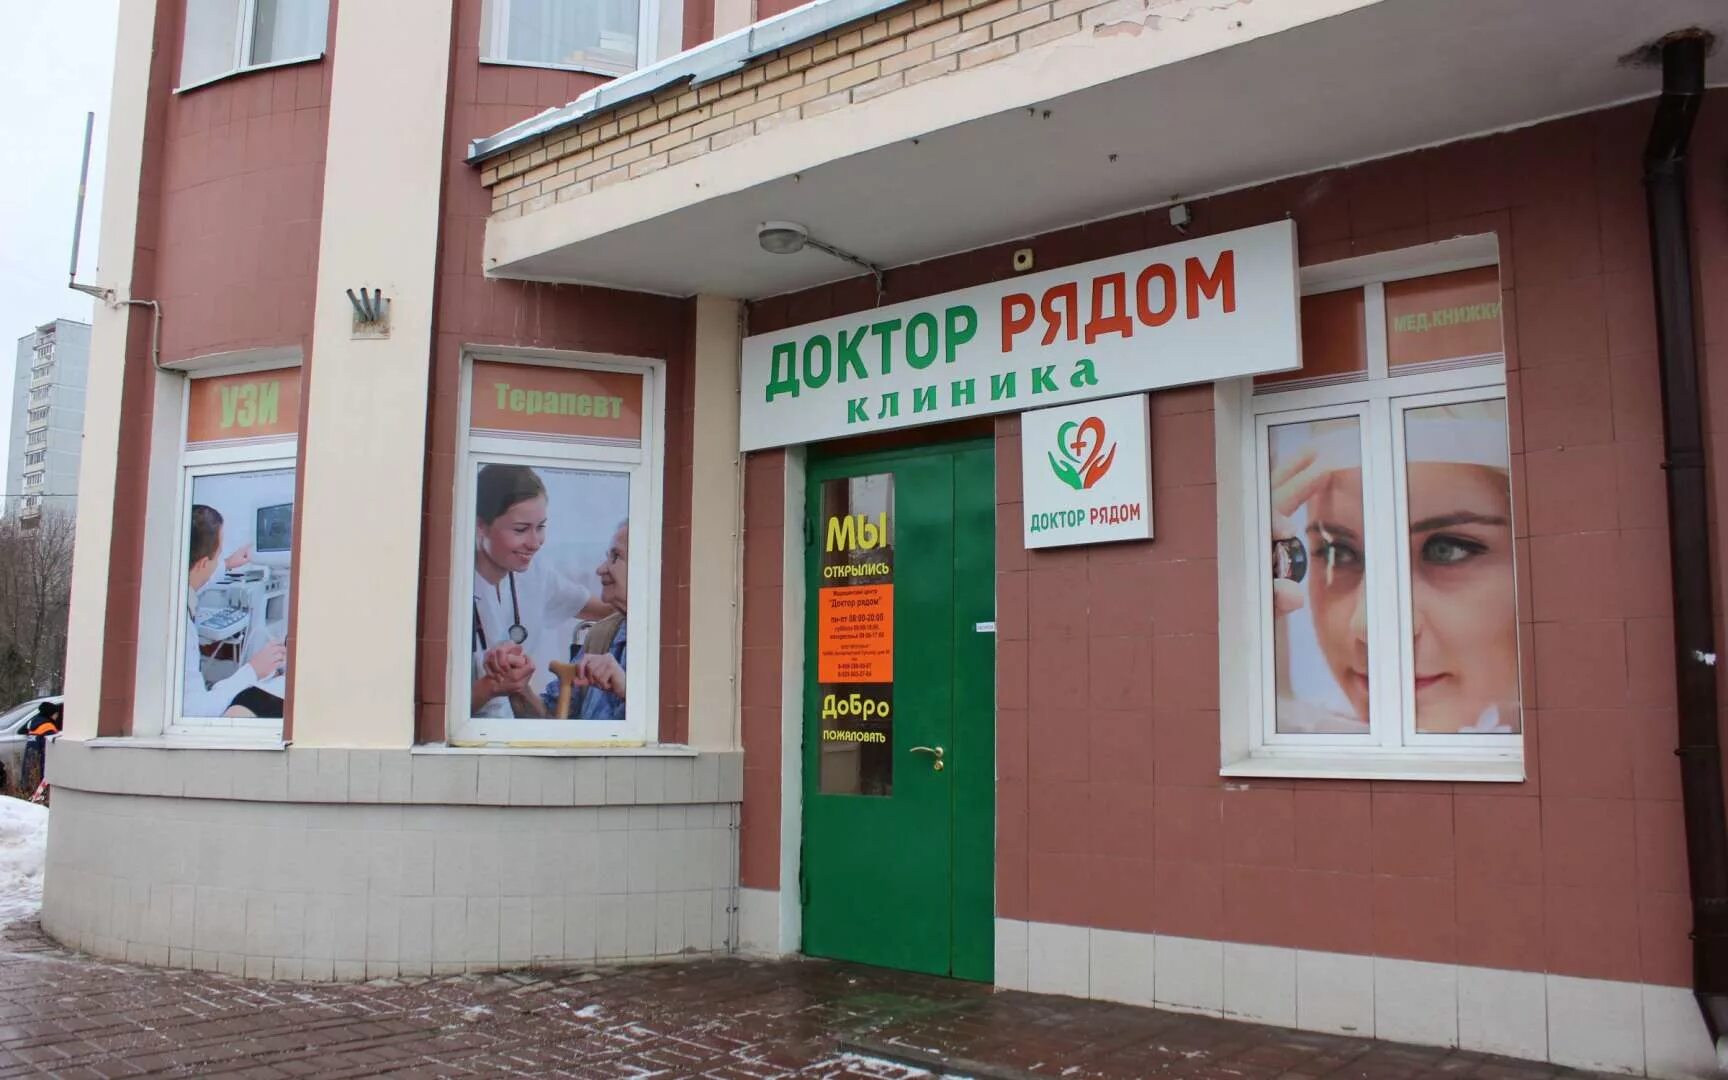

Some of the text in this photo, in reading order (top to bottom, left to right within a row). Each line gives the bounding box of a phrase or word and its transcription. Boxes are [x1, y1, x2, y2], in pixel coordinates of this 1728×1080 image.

[765, 249, 1237, 402] ДОКТОР РЯДОМ
[220, 379, 280, 428] УЗИ
[494, 383, 624, 419] Терапевт
[847, 355, 1099, 424] клиника
[1030, 503, 1141, 533] ДОКТОР РЯДОМ
[822, 693, 890, 721] Добро
